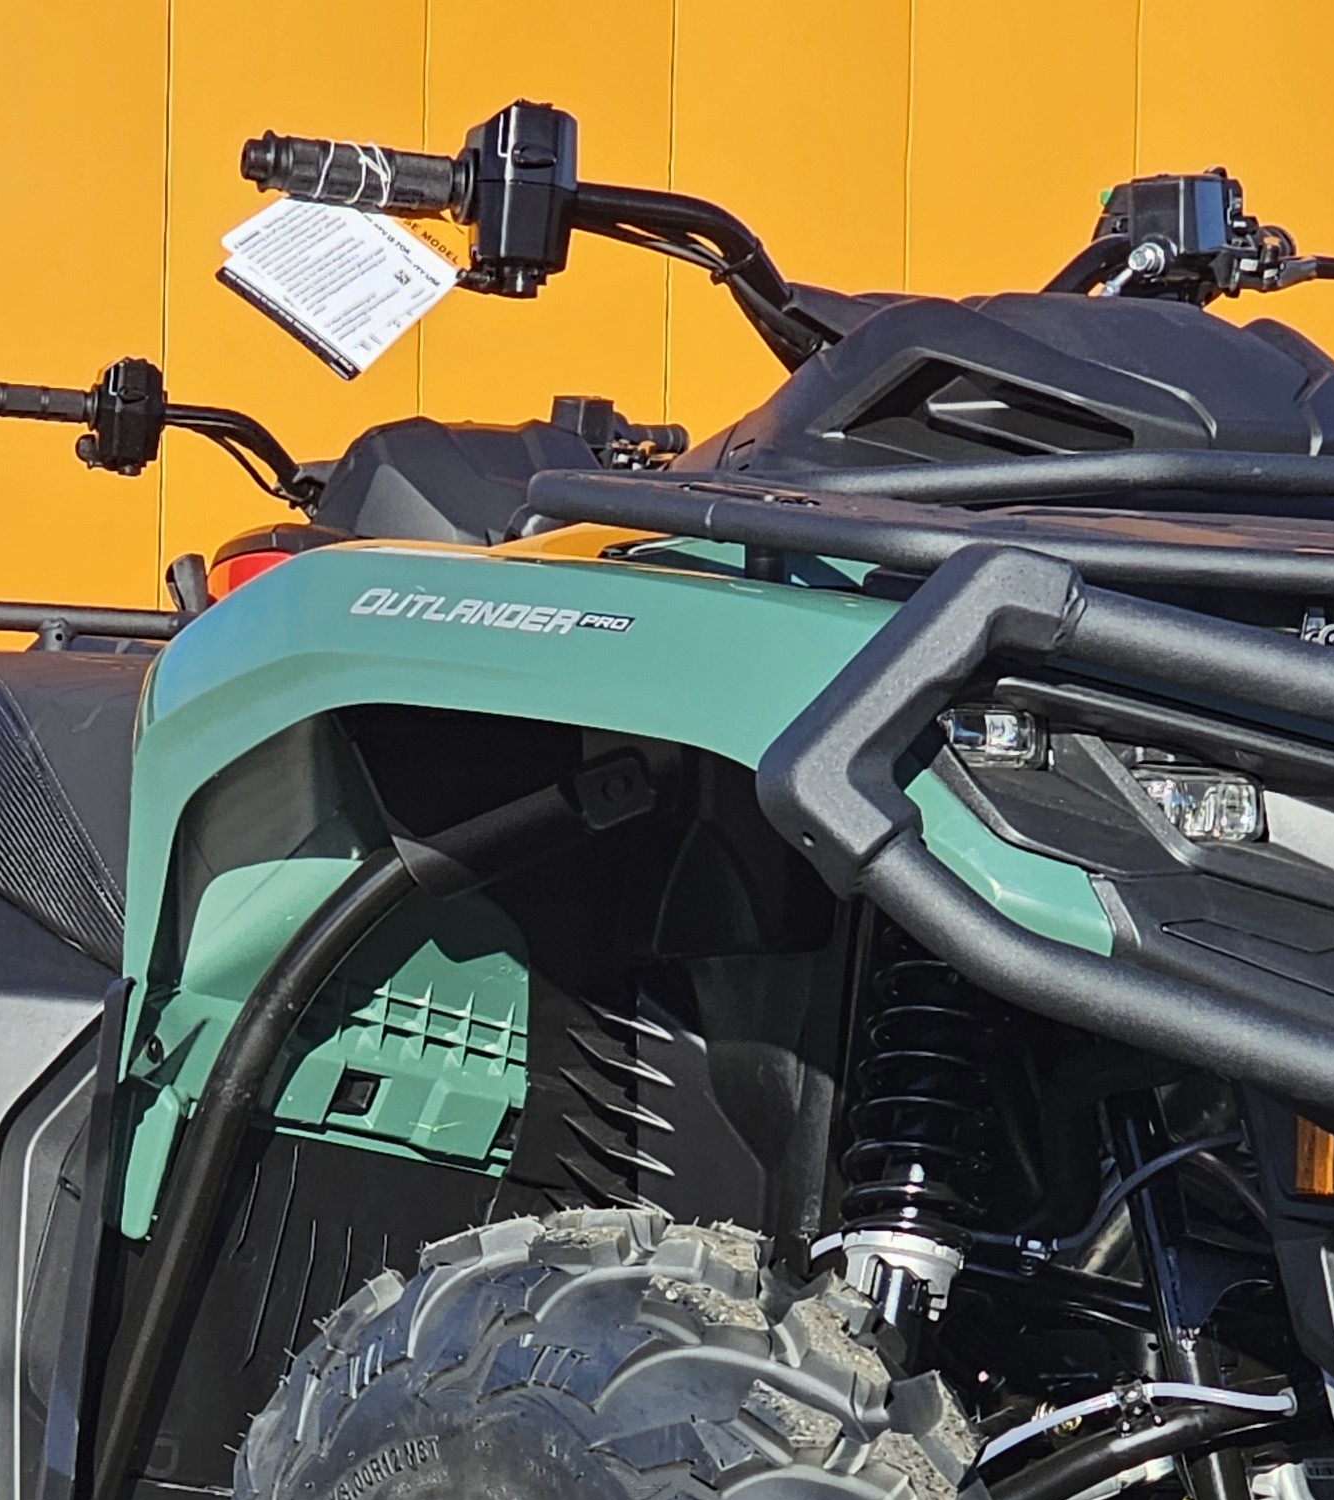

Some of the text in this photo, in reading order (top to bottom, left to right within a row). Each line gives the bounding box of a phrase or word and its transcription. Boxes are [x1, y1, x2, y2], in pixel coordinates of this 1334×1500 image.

[420, 231, 459, 266] MODEL
[350, 587, 632, 634] OUTLANDER PRO
